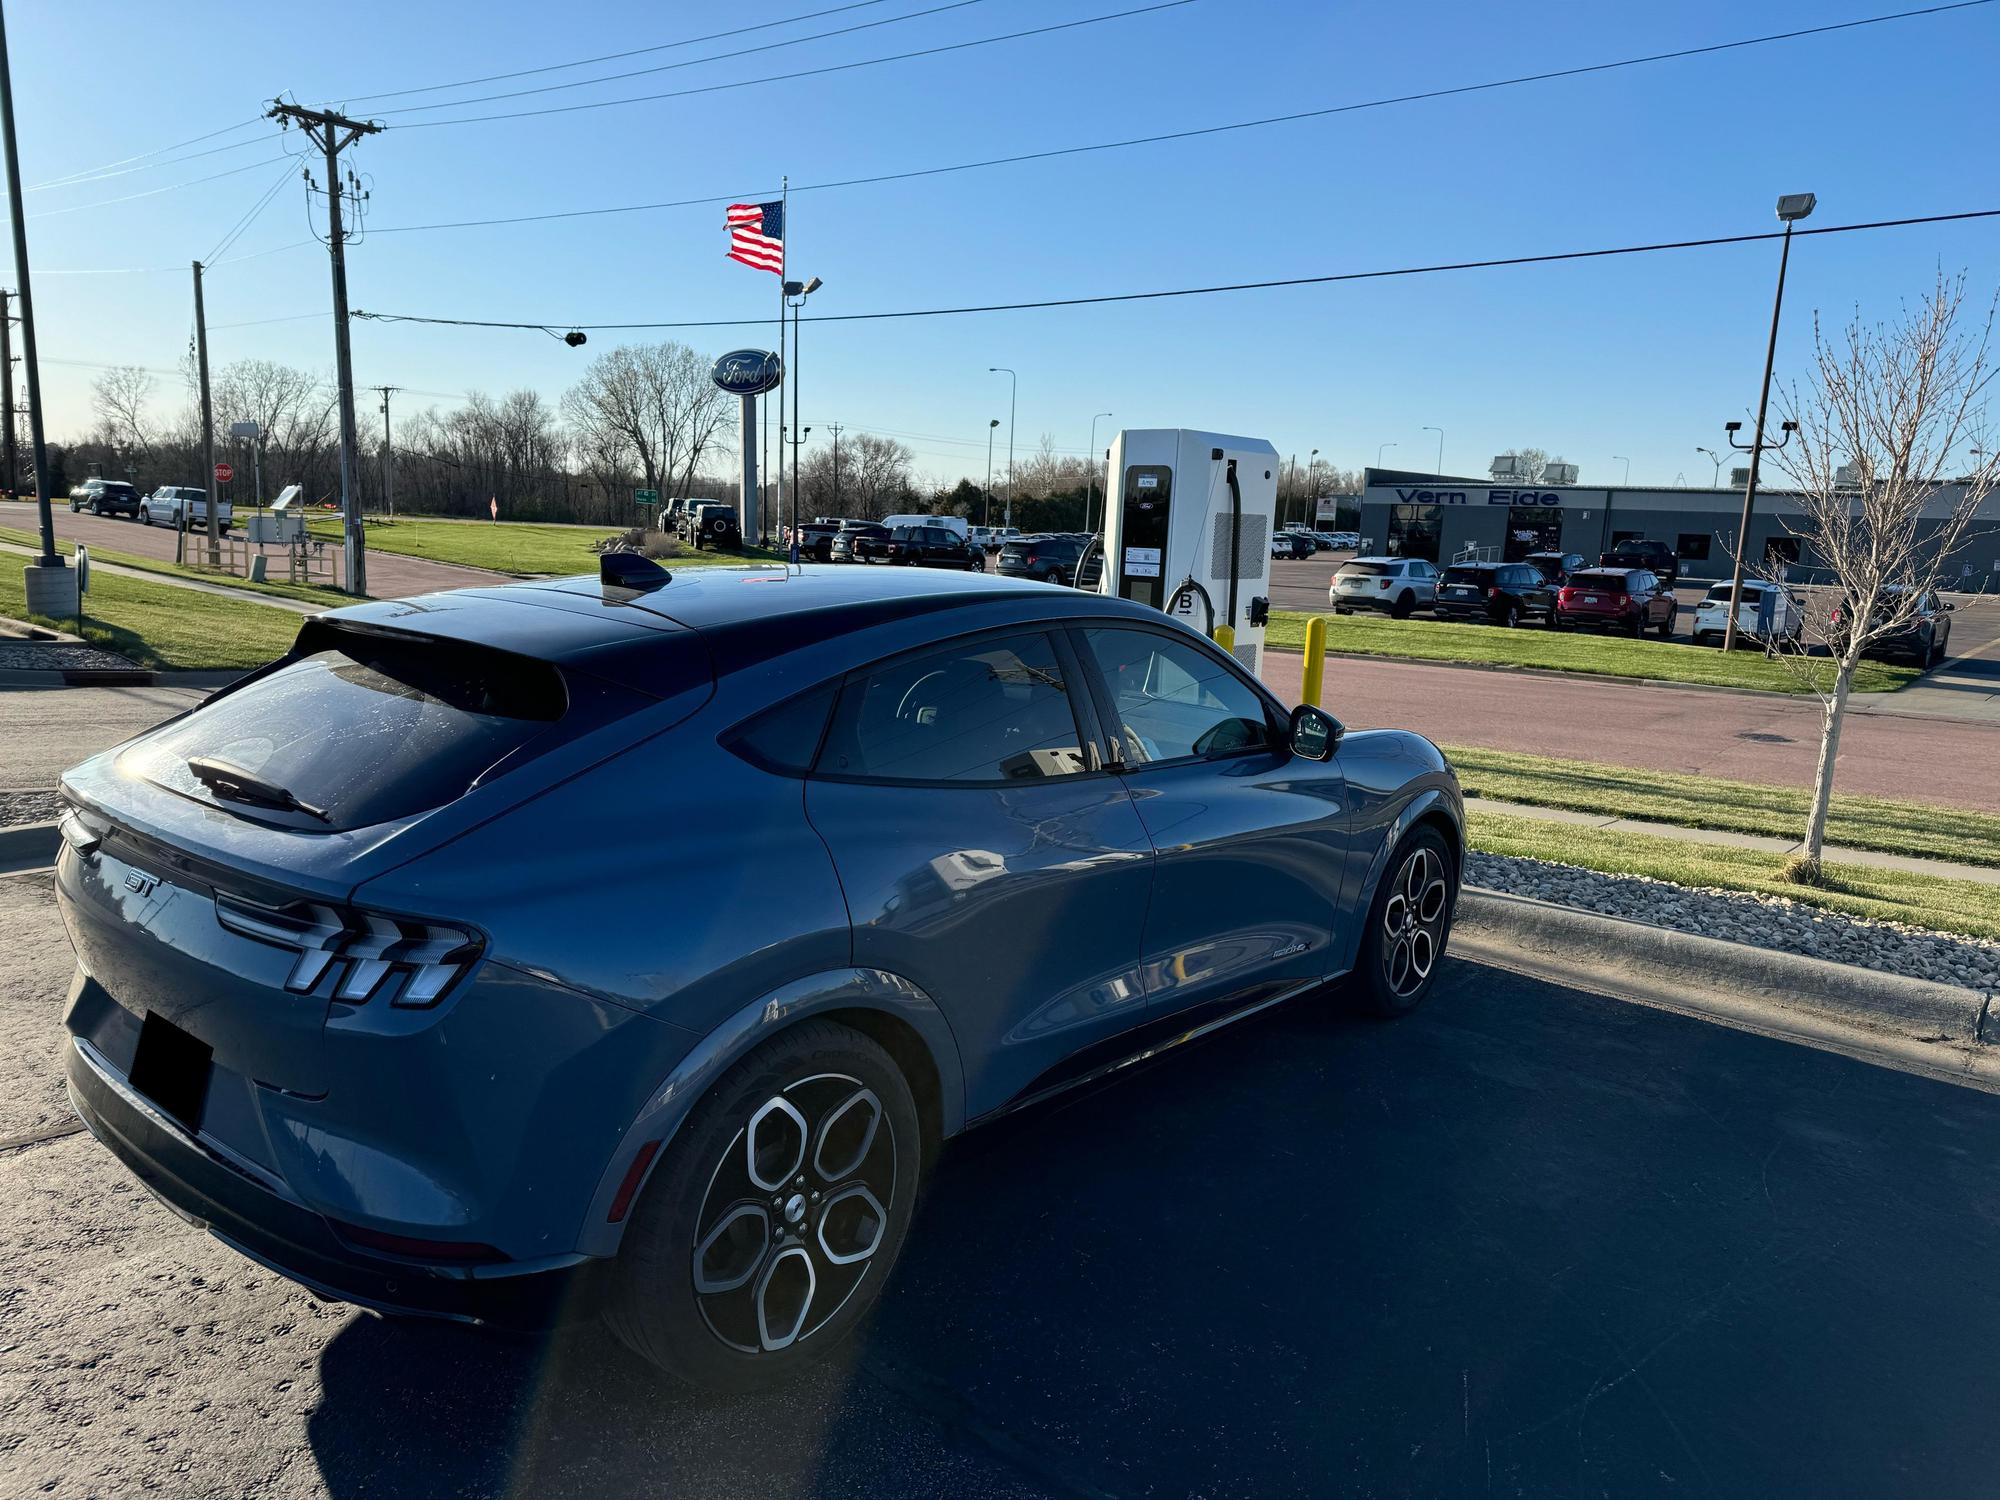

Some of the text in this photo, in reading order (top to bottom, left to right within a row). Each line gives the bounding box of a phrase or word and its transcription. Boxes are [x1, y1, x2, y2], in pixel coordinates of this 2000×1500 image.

[723, 359, 761, 384] Ford
[1396, 489, 1559, 506] Vern Eide
[1180, 594, 1192, 608] B
[124, 867, 161, 897] GT
